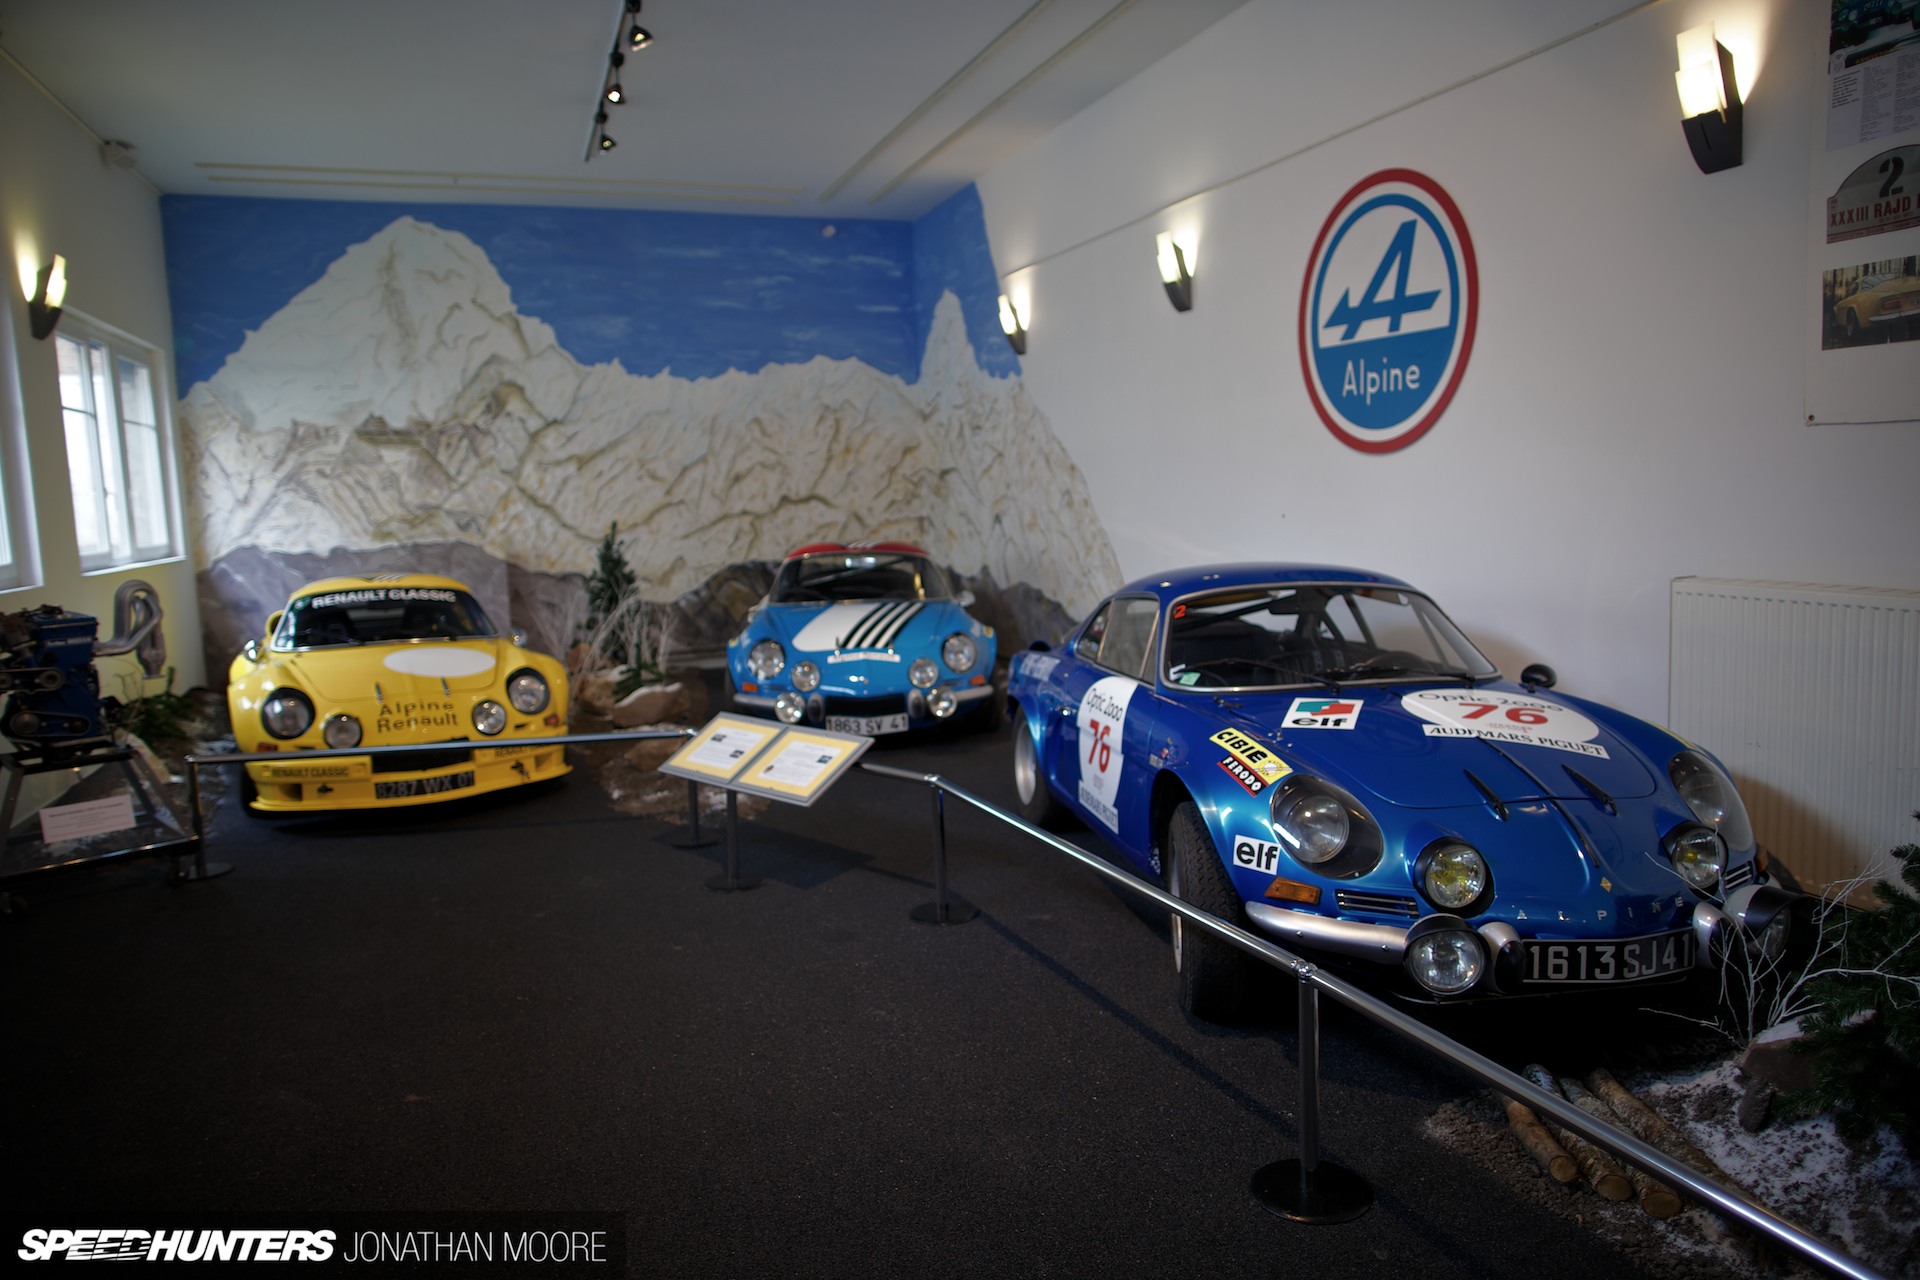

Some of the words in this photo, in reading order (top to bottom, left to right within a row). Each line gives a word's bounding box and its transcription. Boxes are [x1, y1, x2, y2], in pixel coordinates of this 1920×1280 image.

[1879, 157, 1904, 198] 2
[1831, 205, 1868, 227] XXXIII
[1874, 196, 1911, 218] RAJD
[1342, 356, 1421, 405] Alpine
[311, 589, 387, 609] RENAULT
[388, 588, 456, 603] CLASSIC
[380, 701, 454, 717] Alpine
[1087, 688, 1106, 713] Optic
[1418, 693, 1490, 703] Optic
[1496, 697, 1563, 712] 2000
[377, 714, 458, 733] Renault
[1292, 717, 1347, 727] elf
[1458, 702, 1549, 725] 76
[827, 718, 860, 733] 1863
[866, 719, 883, 734] SV
[1089, 718, 1111, 774] 76
[1538, 737, 1604, 756] PIGUET
[1222, 756, 1262, 791] FERODO
[422, 776, 452, 794] WX
[1236, 842, 1279, 871] elf
